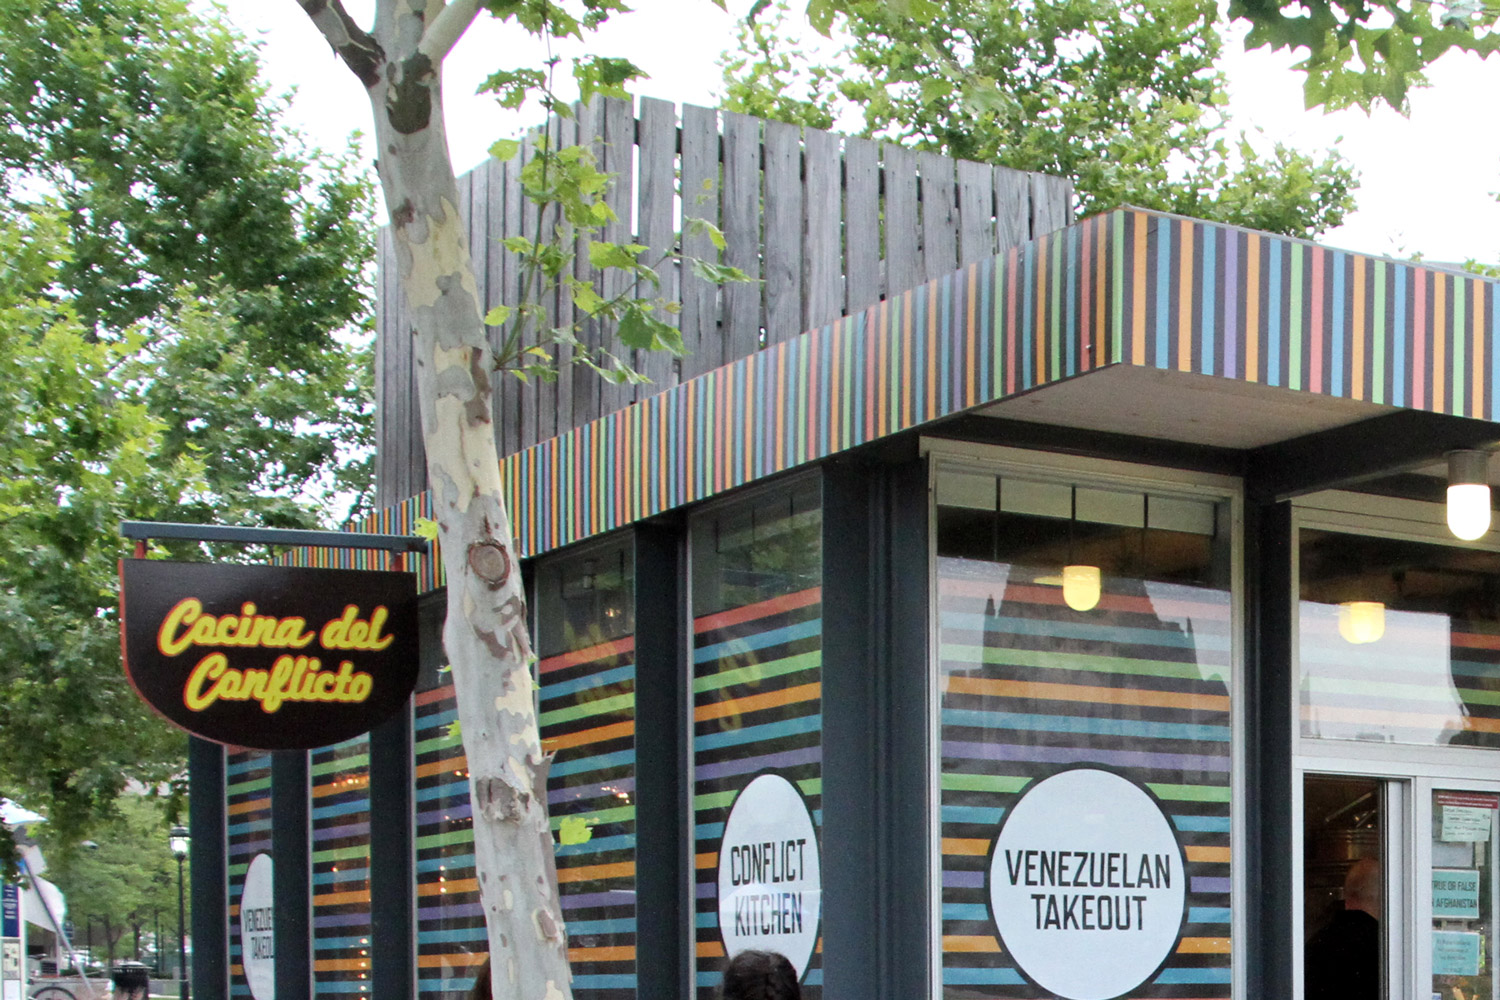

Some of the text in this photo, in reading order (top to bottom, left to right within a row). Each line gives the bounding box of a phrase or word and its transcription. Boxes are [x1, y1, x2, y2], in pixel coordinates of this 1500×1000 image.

[157, 597, 395, 657] Cocina del
[184, 653, 372, 712] Conflicto
[730, 838, 807, 887] CONFLICT
[1005, 849, 1171, 891] VENEZUELAN
[1458, 881, 1476, 892] FALSE
[734, 892, 803, 937] KITCHEN
[1031, 893, 1147, 932] TAKEOUT
